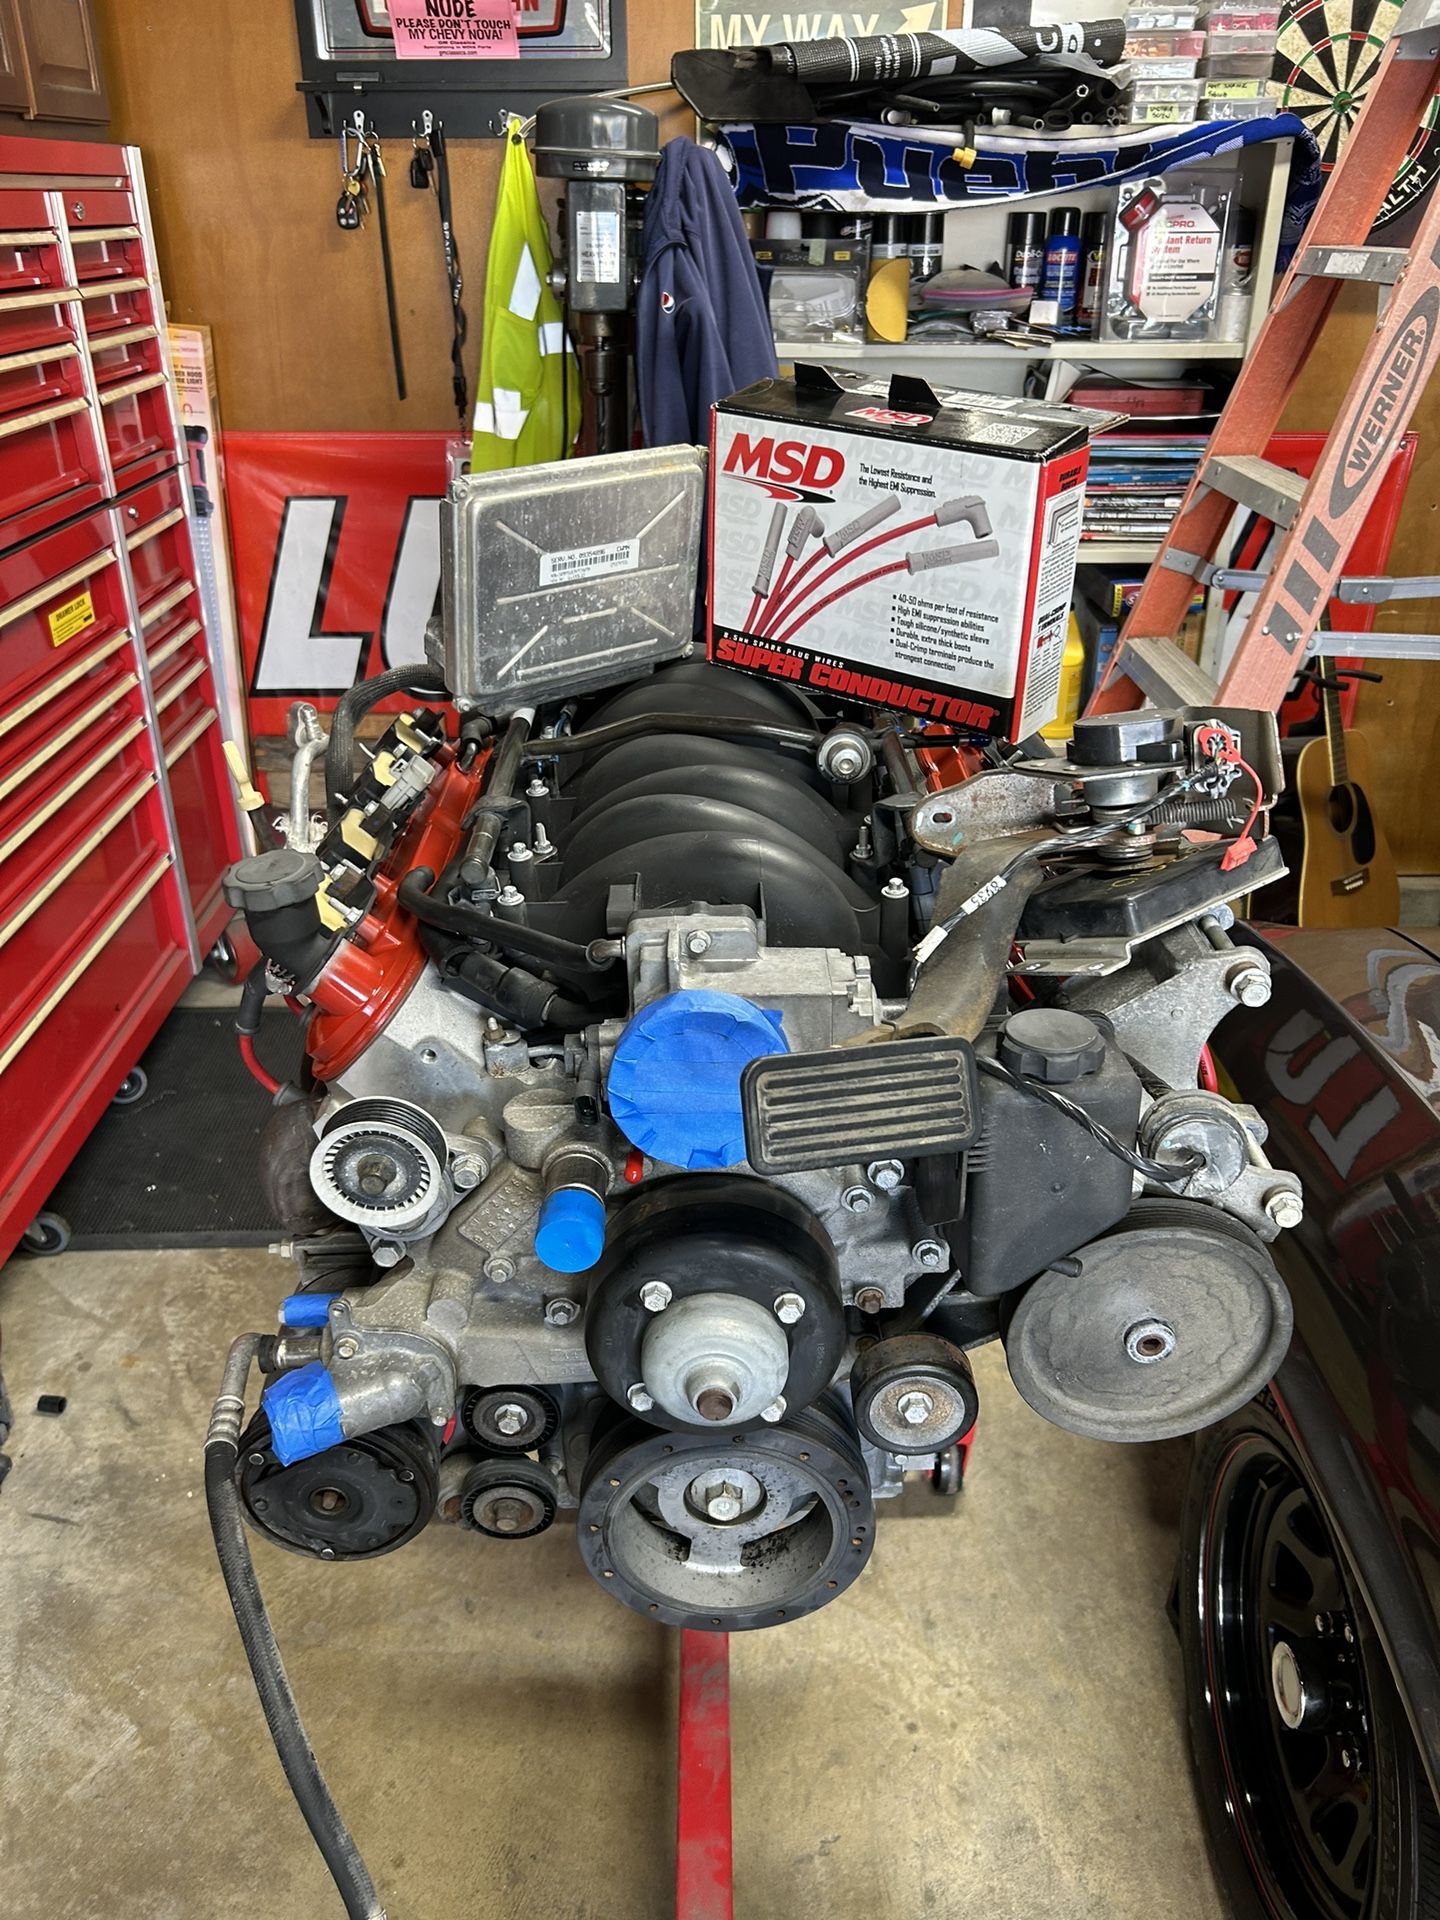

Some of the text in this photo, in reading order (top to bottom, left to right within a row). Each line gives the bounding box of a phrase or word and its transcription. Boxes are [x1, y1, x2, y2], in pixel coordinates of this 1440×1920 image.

[425, 0, 477, 18] NUDE
[396, 17, 511, 30] PLEASE DON'T TOUCH
[408, 28, 503, 40] MY CHEVY NOVA!
[710, 14, 880, 48] MY WAY
[1347, 328, 1425, 473] WERNER
[722, 432, 846, 489] MSD
[859, 462, 933, 484] The Lowest Resistance and
[858, 476, 868, 486] the
[868, 477, 889, 489] Highest
[897, 605, 984, 632] High EMI suppression abilities
[898, 593, 999, 623] 40-50 ohms per foot of resistance
[896, 616, 914, 629] Tough
[969, 633, 990, 645] sleeve
[896, 627, 971, 653] Durable, extra thick boots
[752, 639, 782, 652] SPARK
[786, 648, 811, 660] PLUG
[814, 655, 845, 668] WIRES
[895, 638, 994, 669] Dual-Crimp terminals produce the
[895, 651, 956, 672] strongest connection
[716, 638, 805, 680] SUPER
[808, 662, 994, 730] CONDUCTOR
